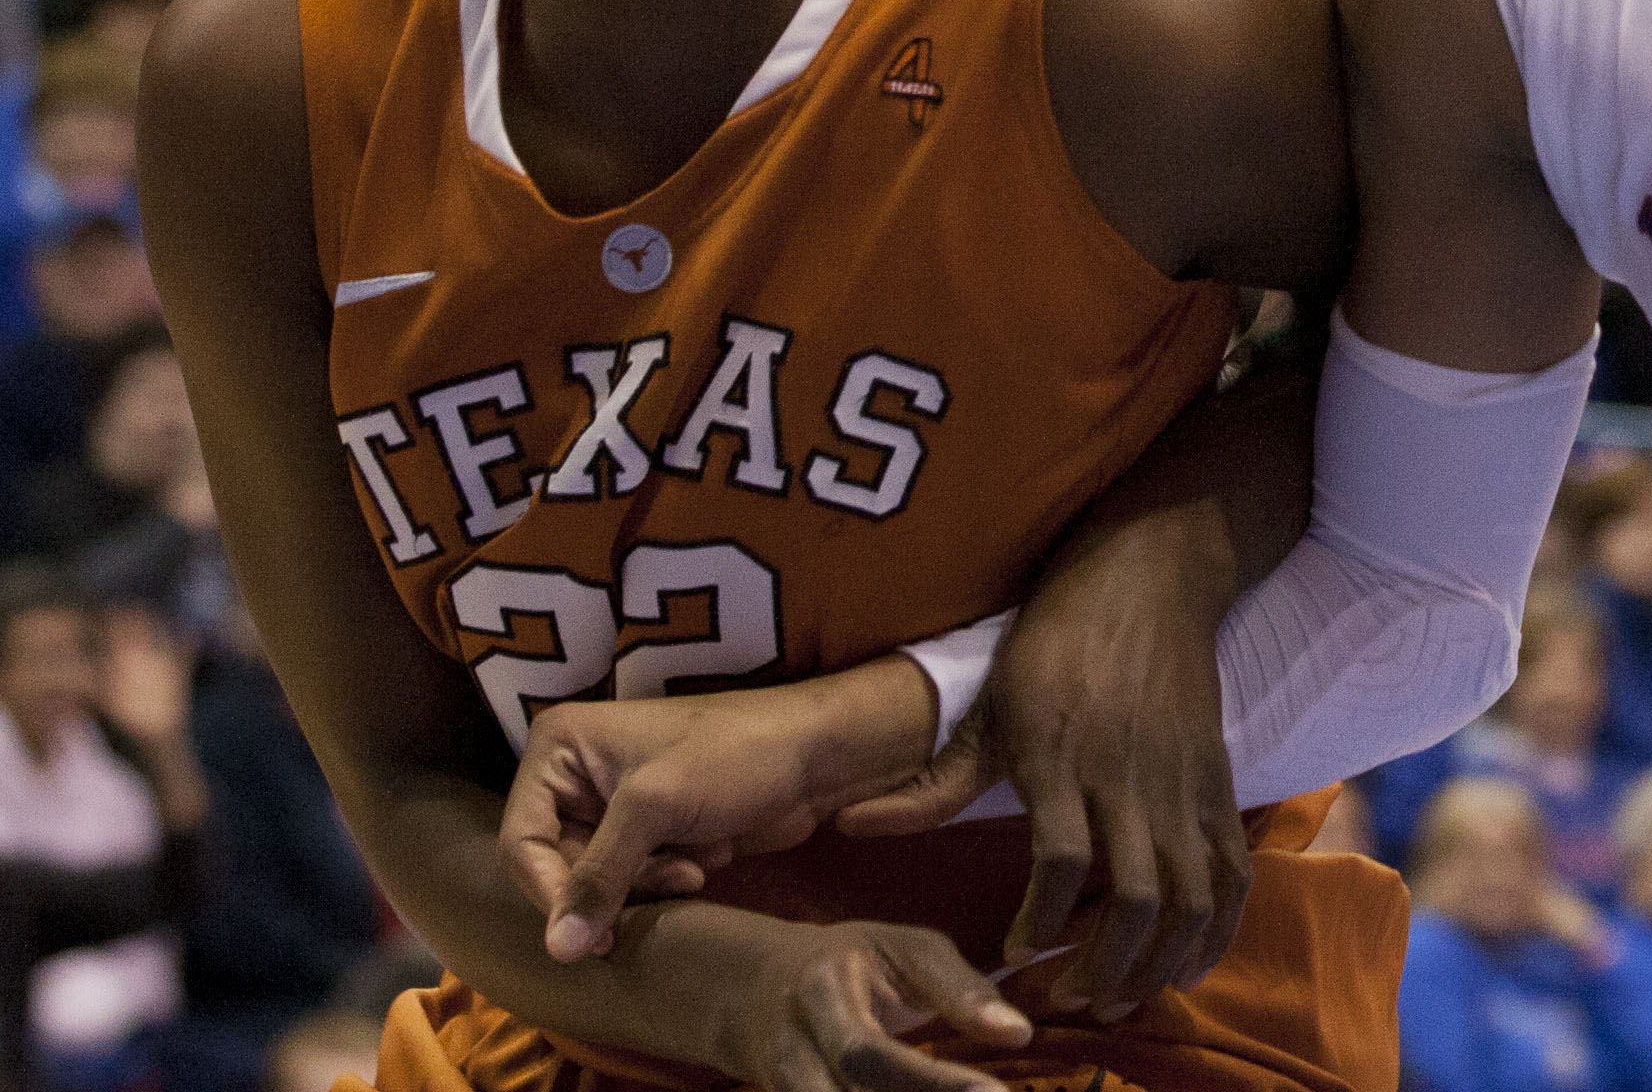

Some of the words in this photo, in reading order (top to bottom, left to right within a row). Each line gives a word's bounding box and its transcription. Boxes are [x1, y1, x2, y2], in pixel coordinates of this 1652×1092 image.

[880, 37, 944, 126] 4
[338, 319, 950, 566] TEXAS
[447, 541, 781, 758] 22
